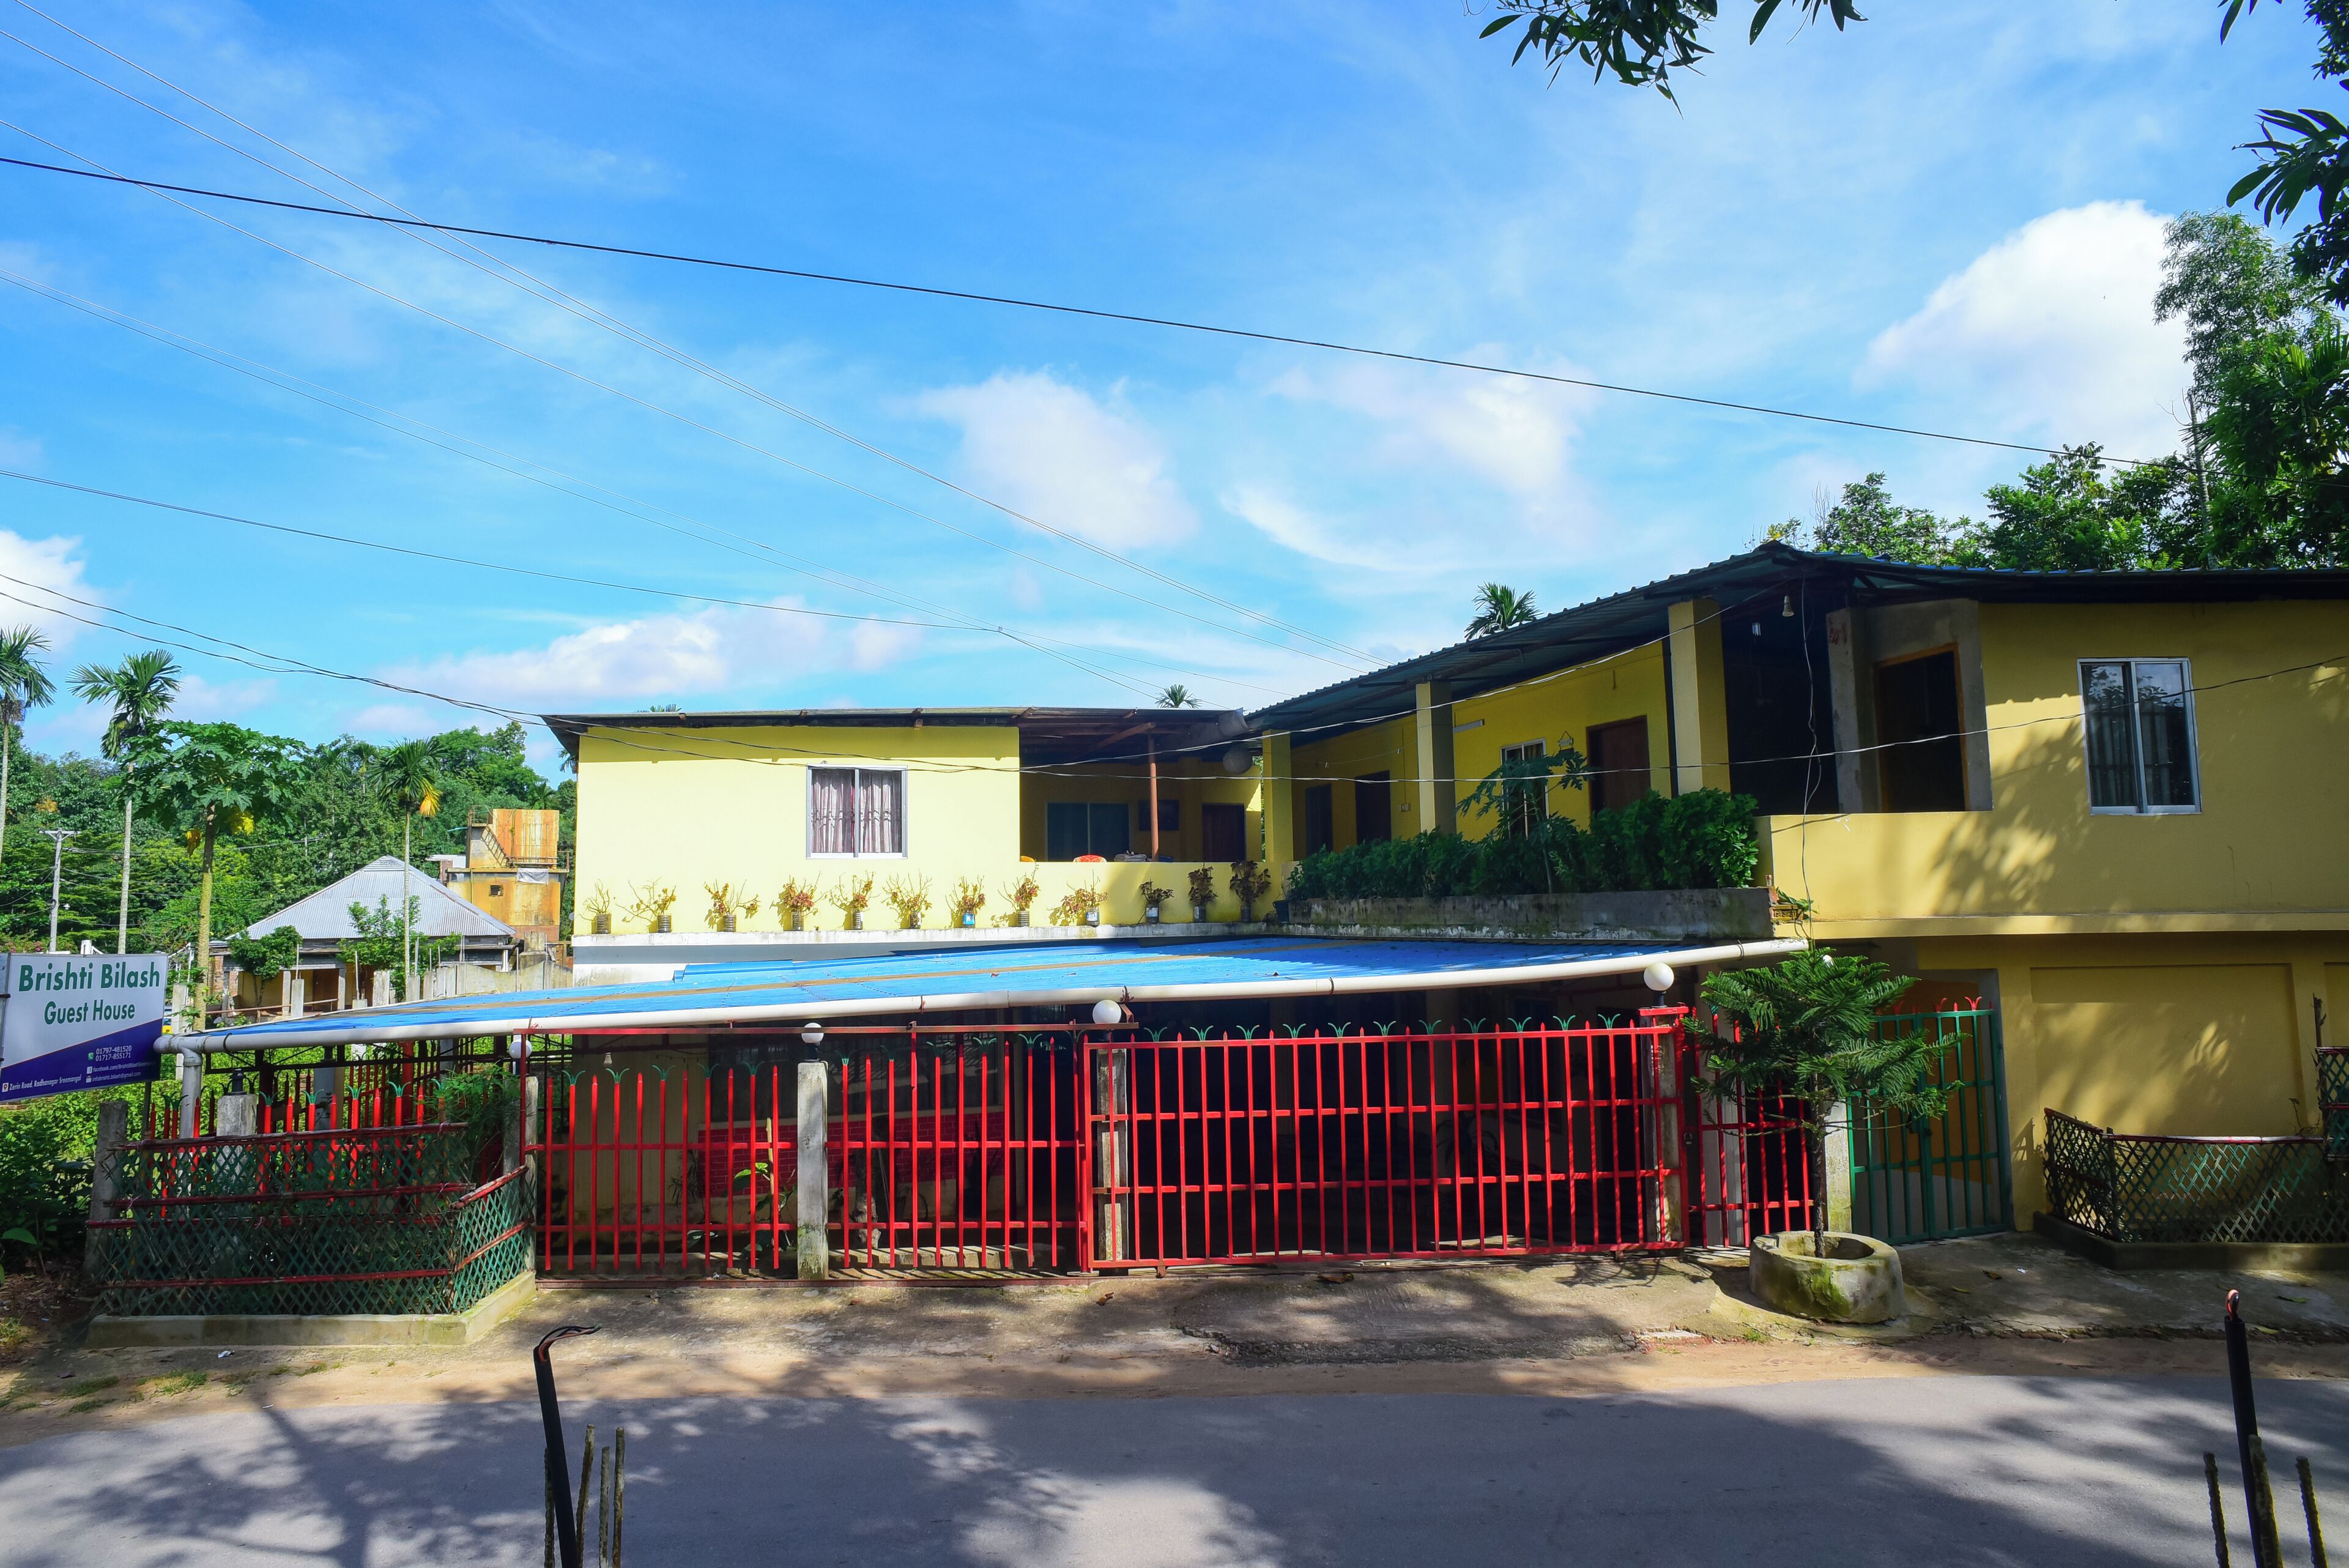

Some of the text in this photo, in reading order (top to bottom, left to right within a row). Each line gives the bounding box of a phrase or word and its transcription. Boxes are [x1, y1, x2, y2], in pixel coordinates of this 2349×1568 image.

[18, 961, 160, 992] Brishti Bilash
[44, 999, 135, 1025] Guest House
[95, 1045, 132, 1055] 01797-481520
[95, 1052, 131, 1061] 01717-855171
[9, 1082, 21, 1091] Zerin
[59, 1074, 82, 1083] Sreemangal
